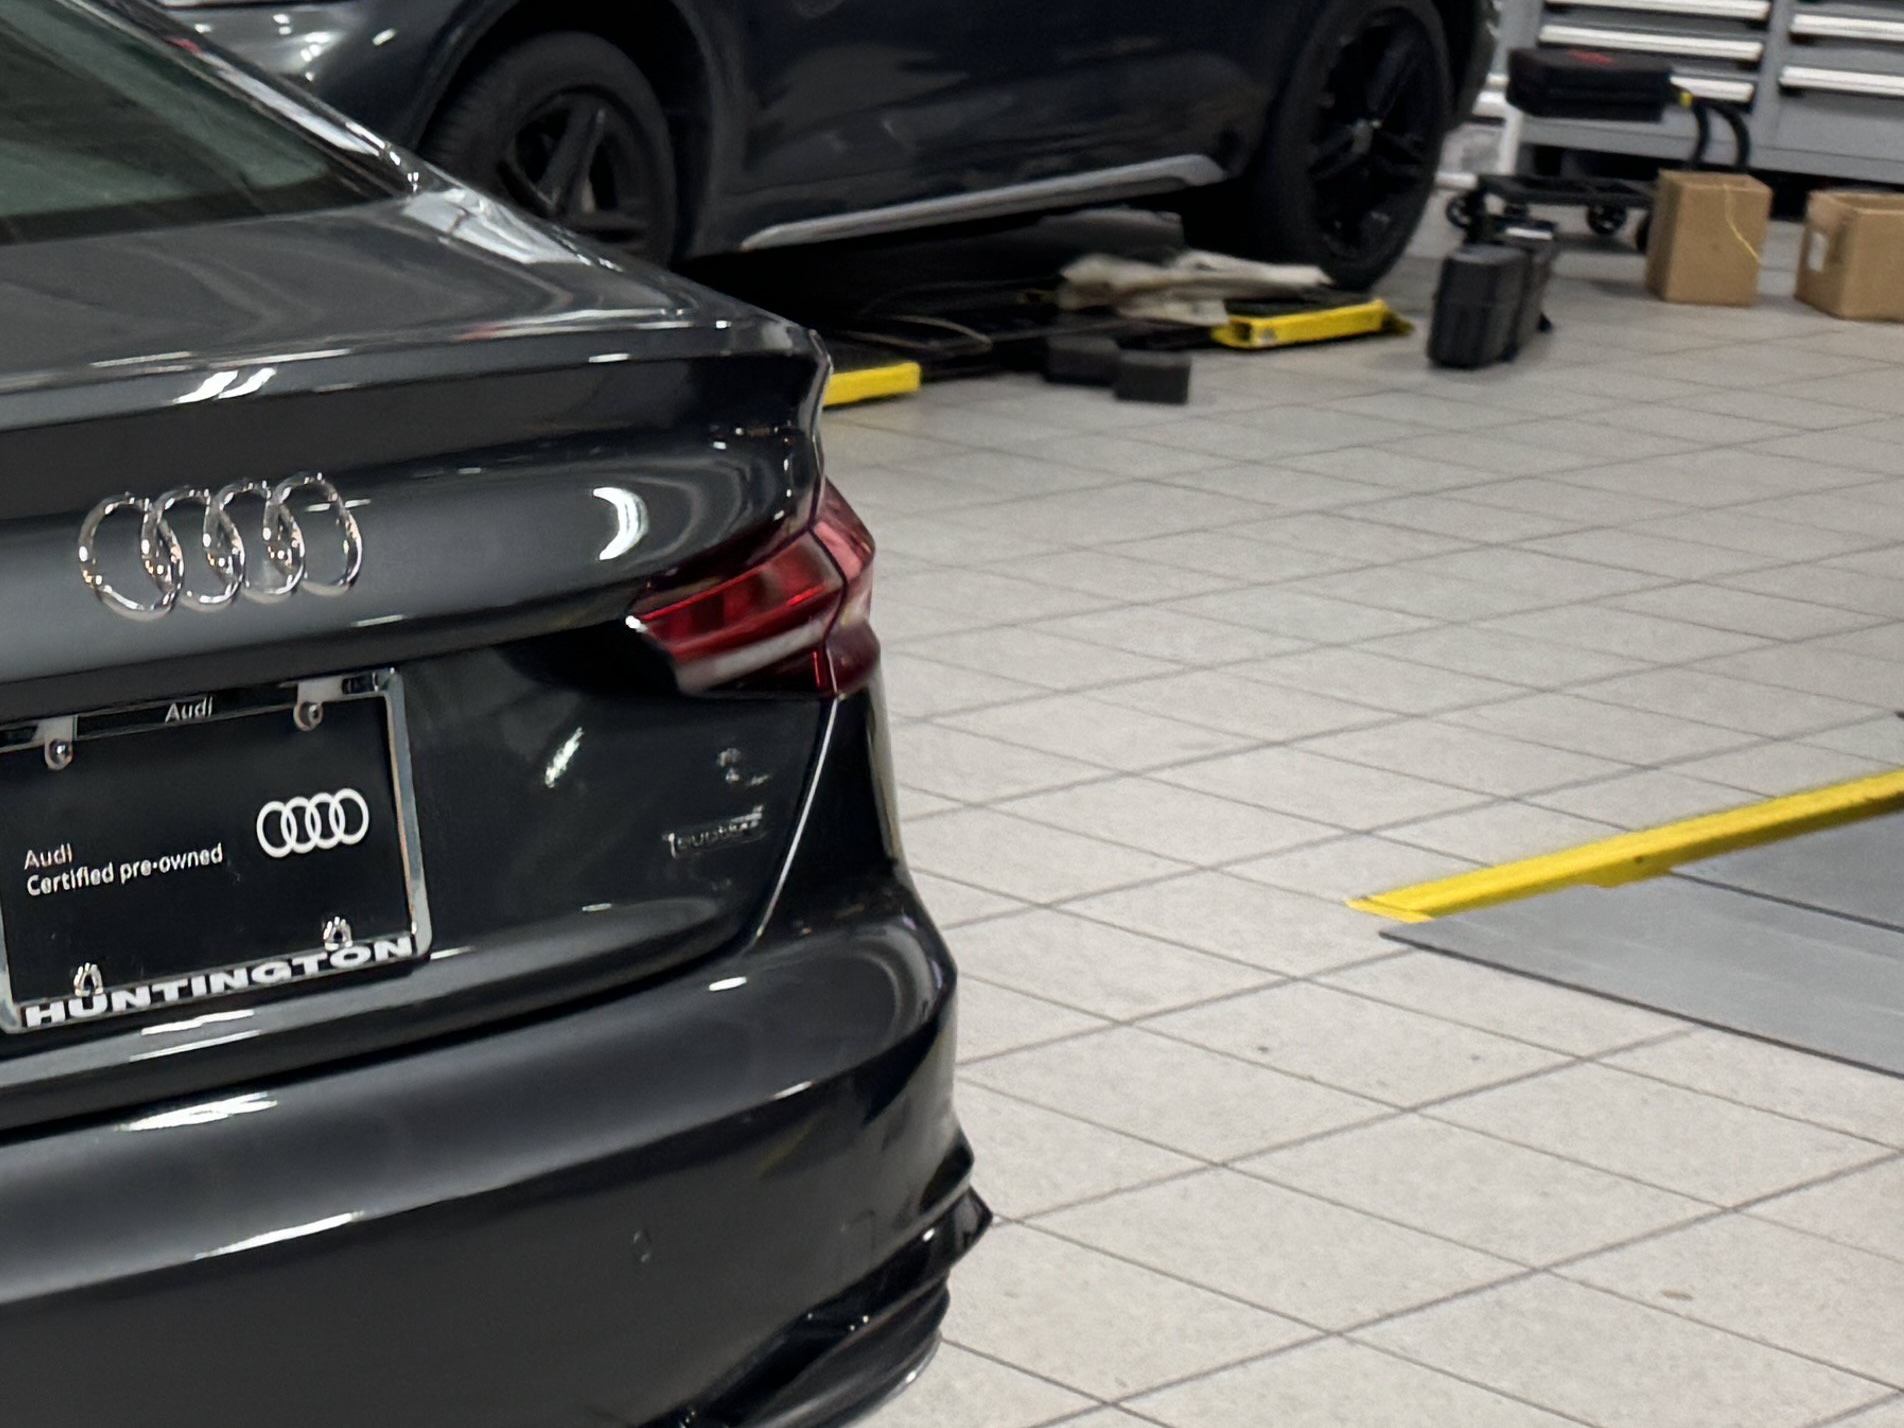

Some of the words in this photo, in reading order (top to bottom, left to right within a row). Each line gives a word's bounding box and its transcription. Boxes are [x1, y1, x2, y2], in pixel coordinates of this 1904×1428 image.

[164, 696, 215, 723] Audi
[23, 843, 73, 871] Audi
[26, 861, 115, 898] Certified
[119, 843, 225, 886] pre-owned
[24, 935, 416, 1029] HUNTINGTON
